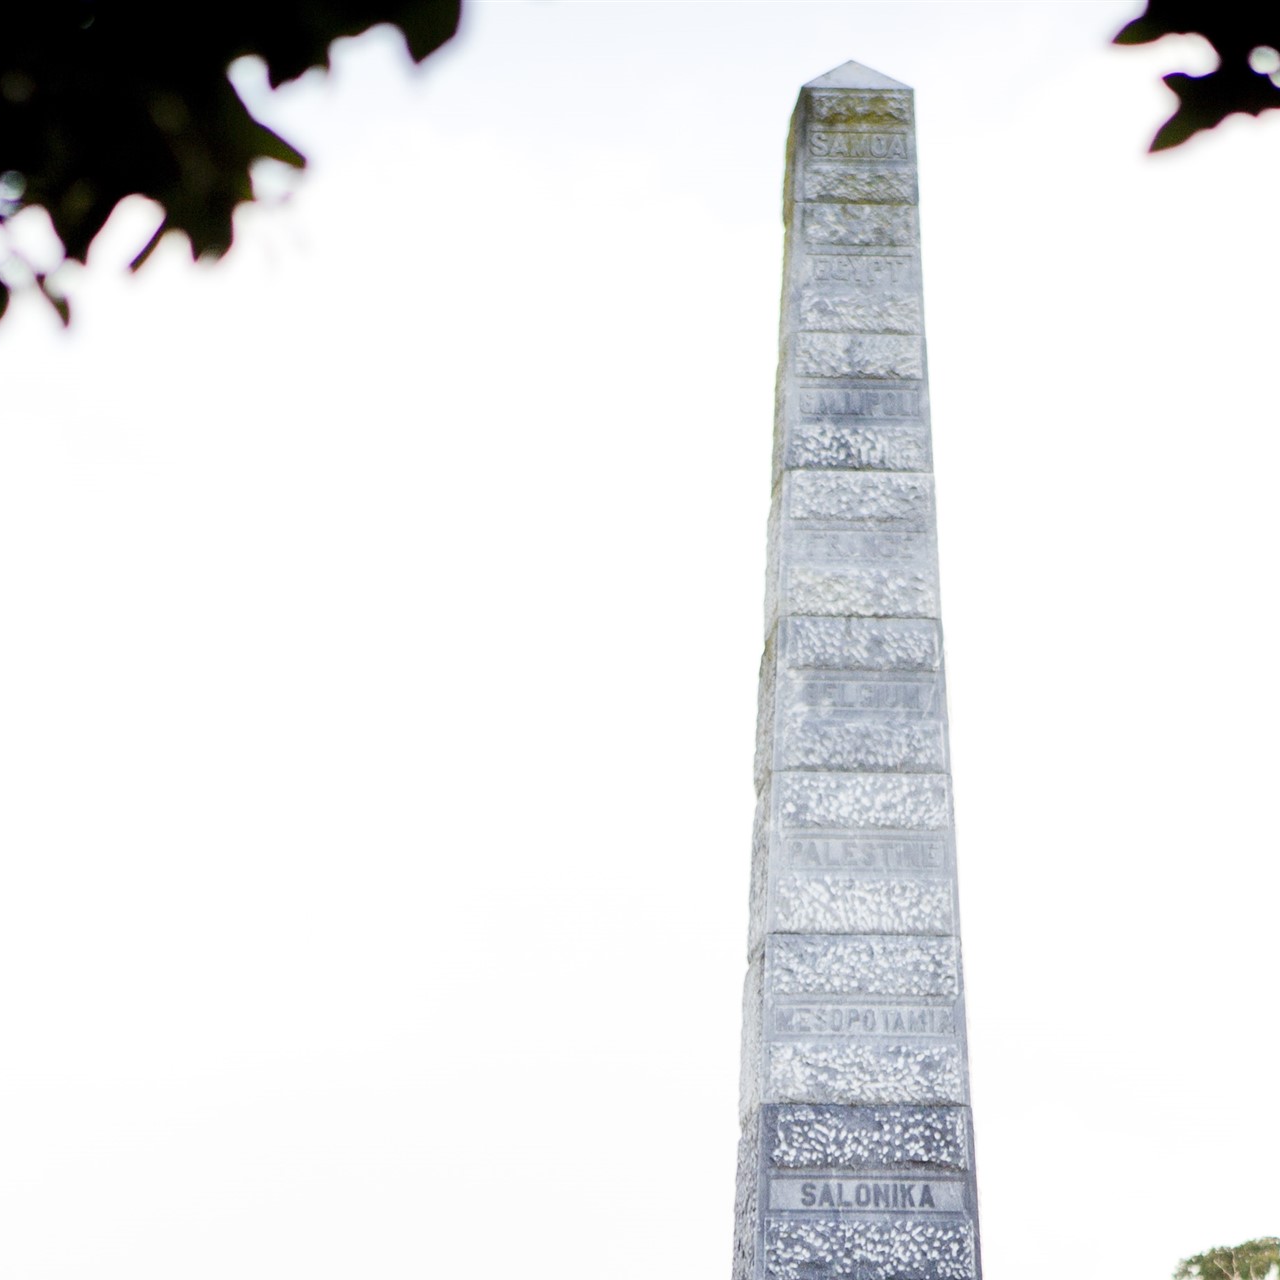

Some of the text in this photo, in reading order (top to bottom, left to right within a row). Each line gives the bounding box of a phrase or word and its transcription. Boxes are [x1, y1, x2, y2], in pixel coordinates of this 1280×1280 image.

[809, 132, 908, 160] SAMOA
[813, 257, 905, 283] EGYPT
[791, 840, 941, 869] PALESTINE
[775, 1007, 956, 1034] MESOPOTAMIA
[800, 1182, 936, 1209] SALONIKA
